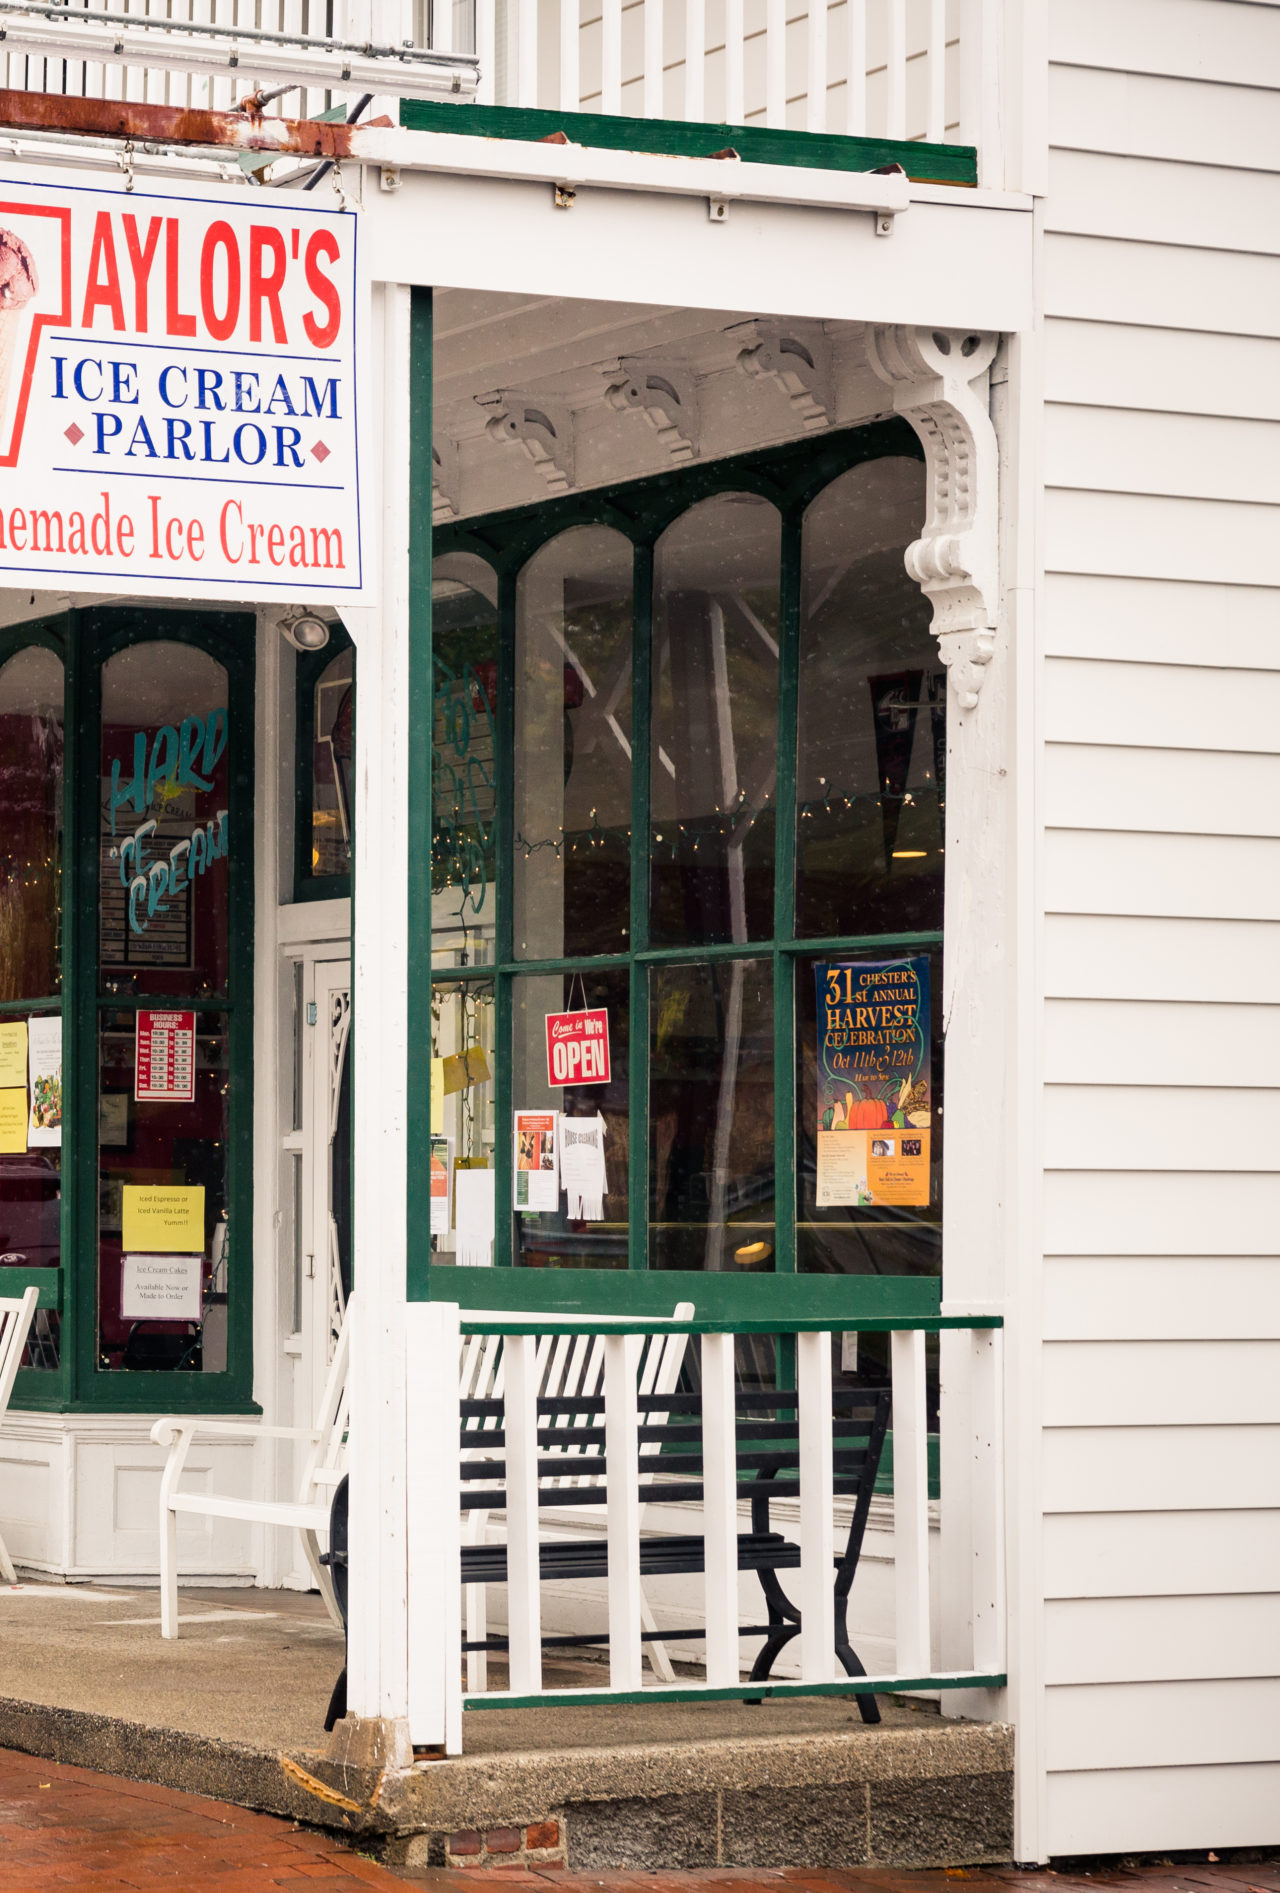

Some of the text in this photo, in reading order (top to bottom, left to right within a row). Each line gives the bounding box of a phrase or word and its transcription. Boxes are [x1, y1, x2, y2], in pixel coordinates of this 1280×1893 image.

[50, 356, 342, 419] ICE CREAM
[91, 412, 306, 468] PARLOR
[147, 496, 205, 561] Ice
[220, 499, 346, 569] Cream
[110, 707, 228, 836] HARD
[129, 810, 228, 934] CREAM
[825, 968, 917, 1005] 31st ANNUAL
[859, 970, 917, 986] CHESTER'S
[150, 1013, 182, 1021] BUSINESS
[153, 1021, 179, 1029] HOURS:
[552, 1018, 603, 1038] Come in We're
[825, 1004, 917, 1030] HARVEST
[825, 1028, 916, 1047] CELEBRATION
[553, 1039, 605, 1080] OPEN
[833, 1052, 851, 1069] Oct
[853, 1050, 876, 1068] 11th
[891, 1048, 914, 1067] 12th
